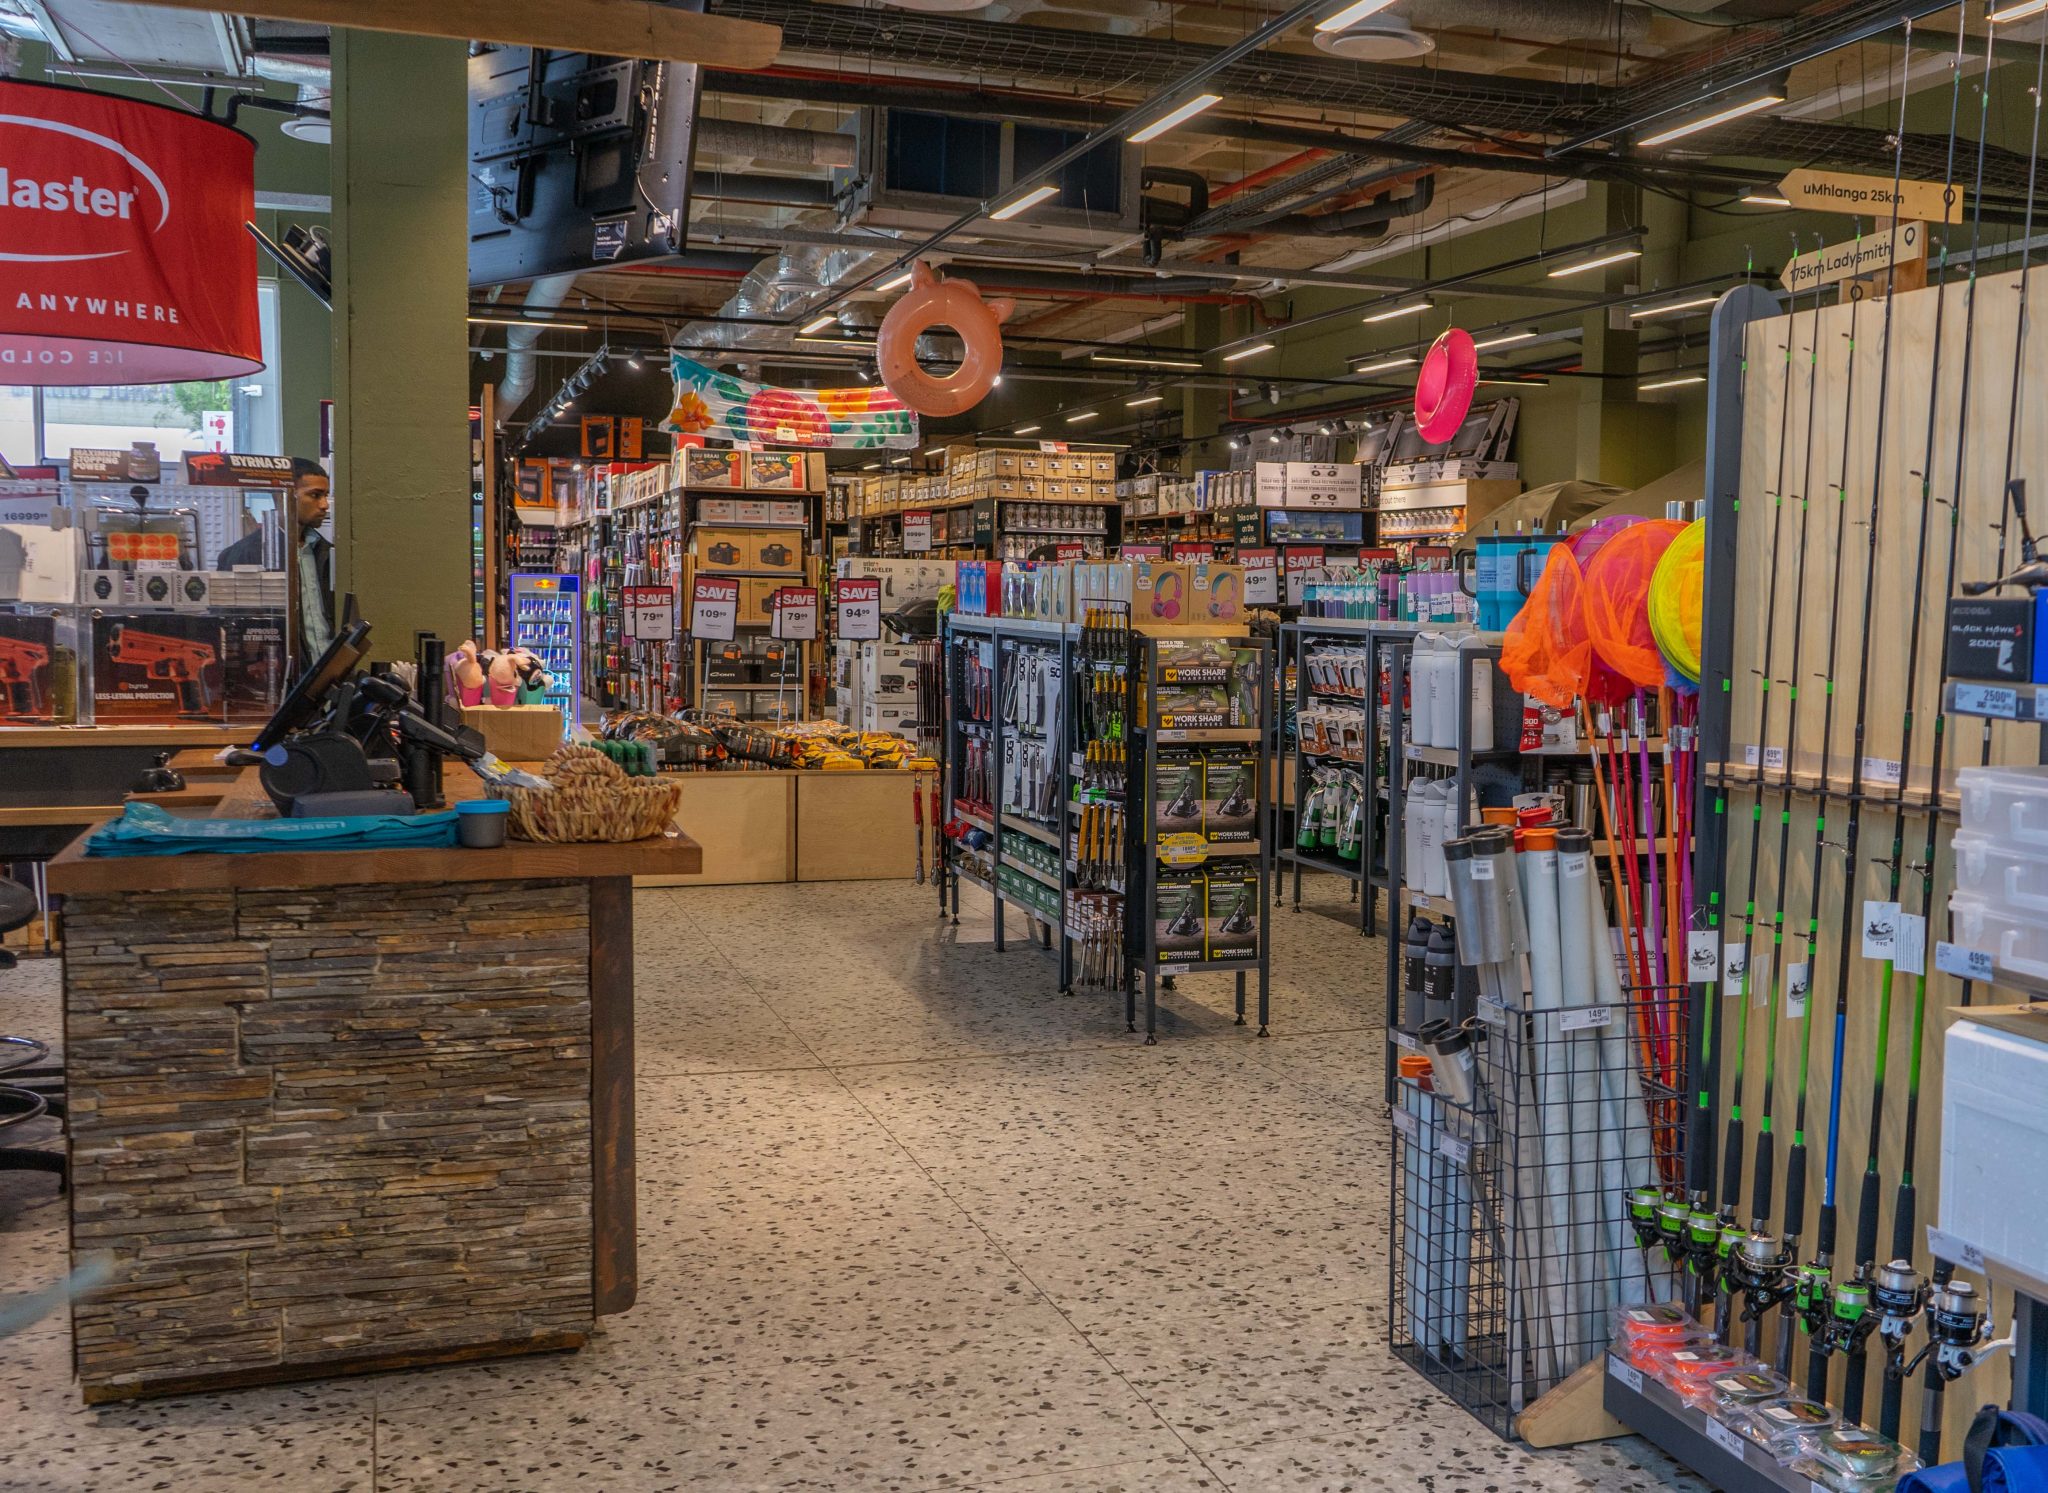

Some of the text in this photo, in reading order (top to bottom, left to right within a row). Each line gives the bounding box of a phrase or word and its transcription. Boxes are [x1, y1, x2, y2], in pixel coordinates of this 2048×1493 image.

[0, 168, 134, 219] aster
[1804, 184, 1904, 204] uMhlanga 25km
[1790, 243, 1892, 282] 175km Ladysmith
[17, 292, 180, 324] ANYWHERE
[73, 457, 119, 465] STOPPING
[230, 455, 291, 469] BYRNA SD
[73, 463, 106, 472] POWER
[904, 516, 930, 525] SAVE
[1058, 550, 1082, 558] SAVE
[1175, 552, 1210, 564] SAVE
[1239, 556, 1274, 568] SAVE
[1288, 555, 1324, 568] SAVE
[696, 585, 736, 600] SAVE
[839, 587, 879, 600] SAVE
[637, 594, 671, 604] SAVE
[783, 594, 816, 605] SAVE
[1952, 624, 2015, 635] BLACK HAWK
